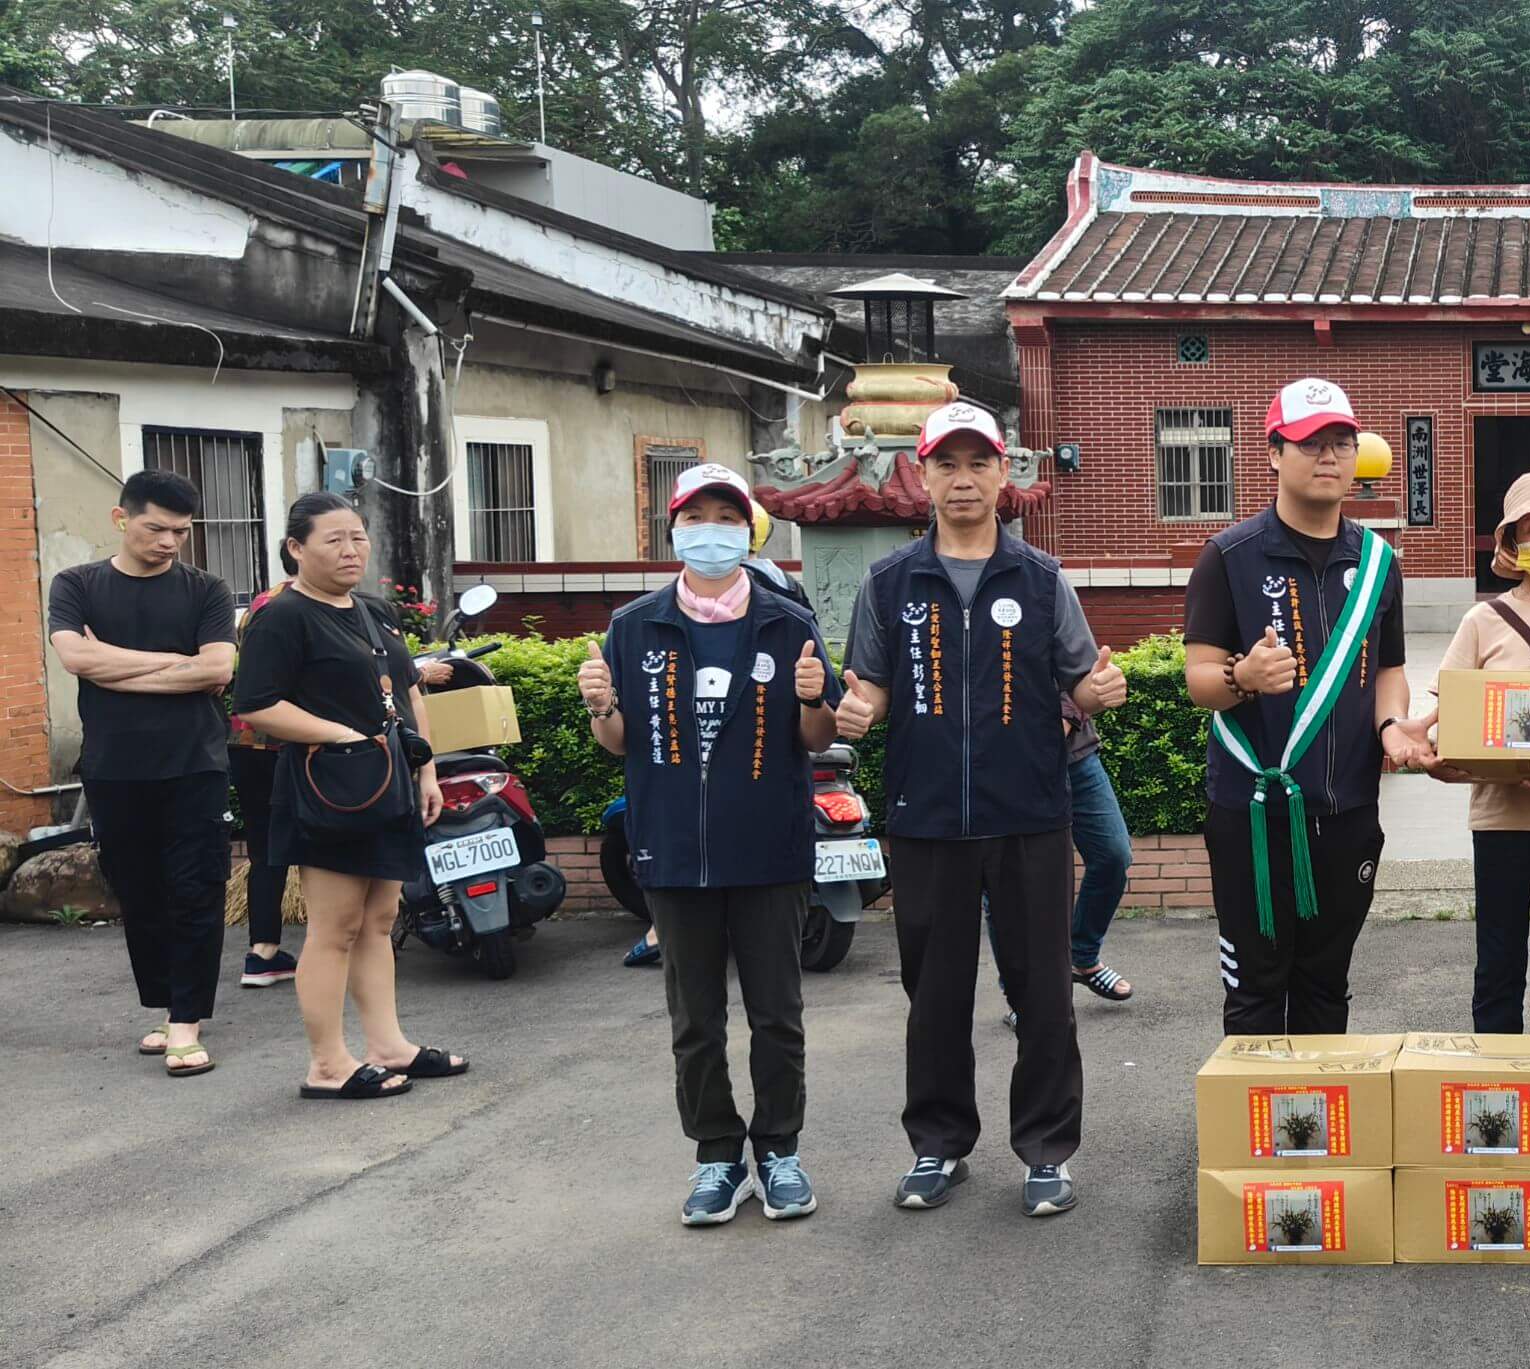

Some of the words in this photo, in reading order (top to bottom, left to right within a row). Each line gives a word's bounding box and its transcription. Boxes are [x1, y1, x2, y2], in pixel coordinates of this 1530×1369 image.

[1411, 426, 1429, 517] 南洲世澤長
[695, 701, 716, 714] MY
